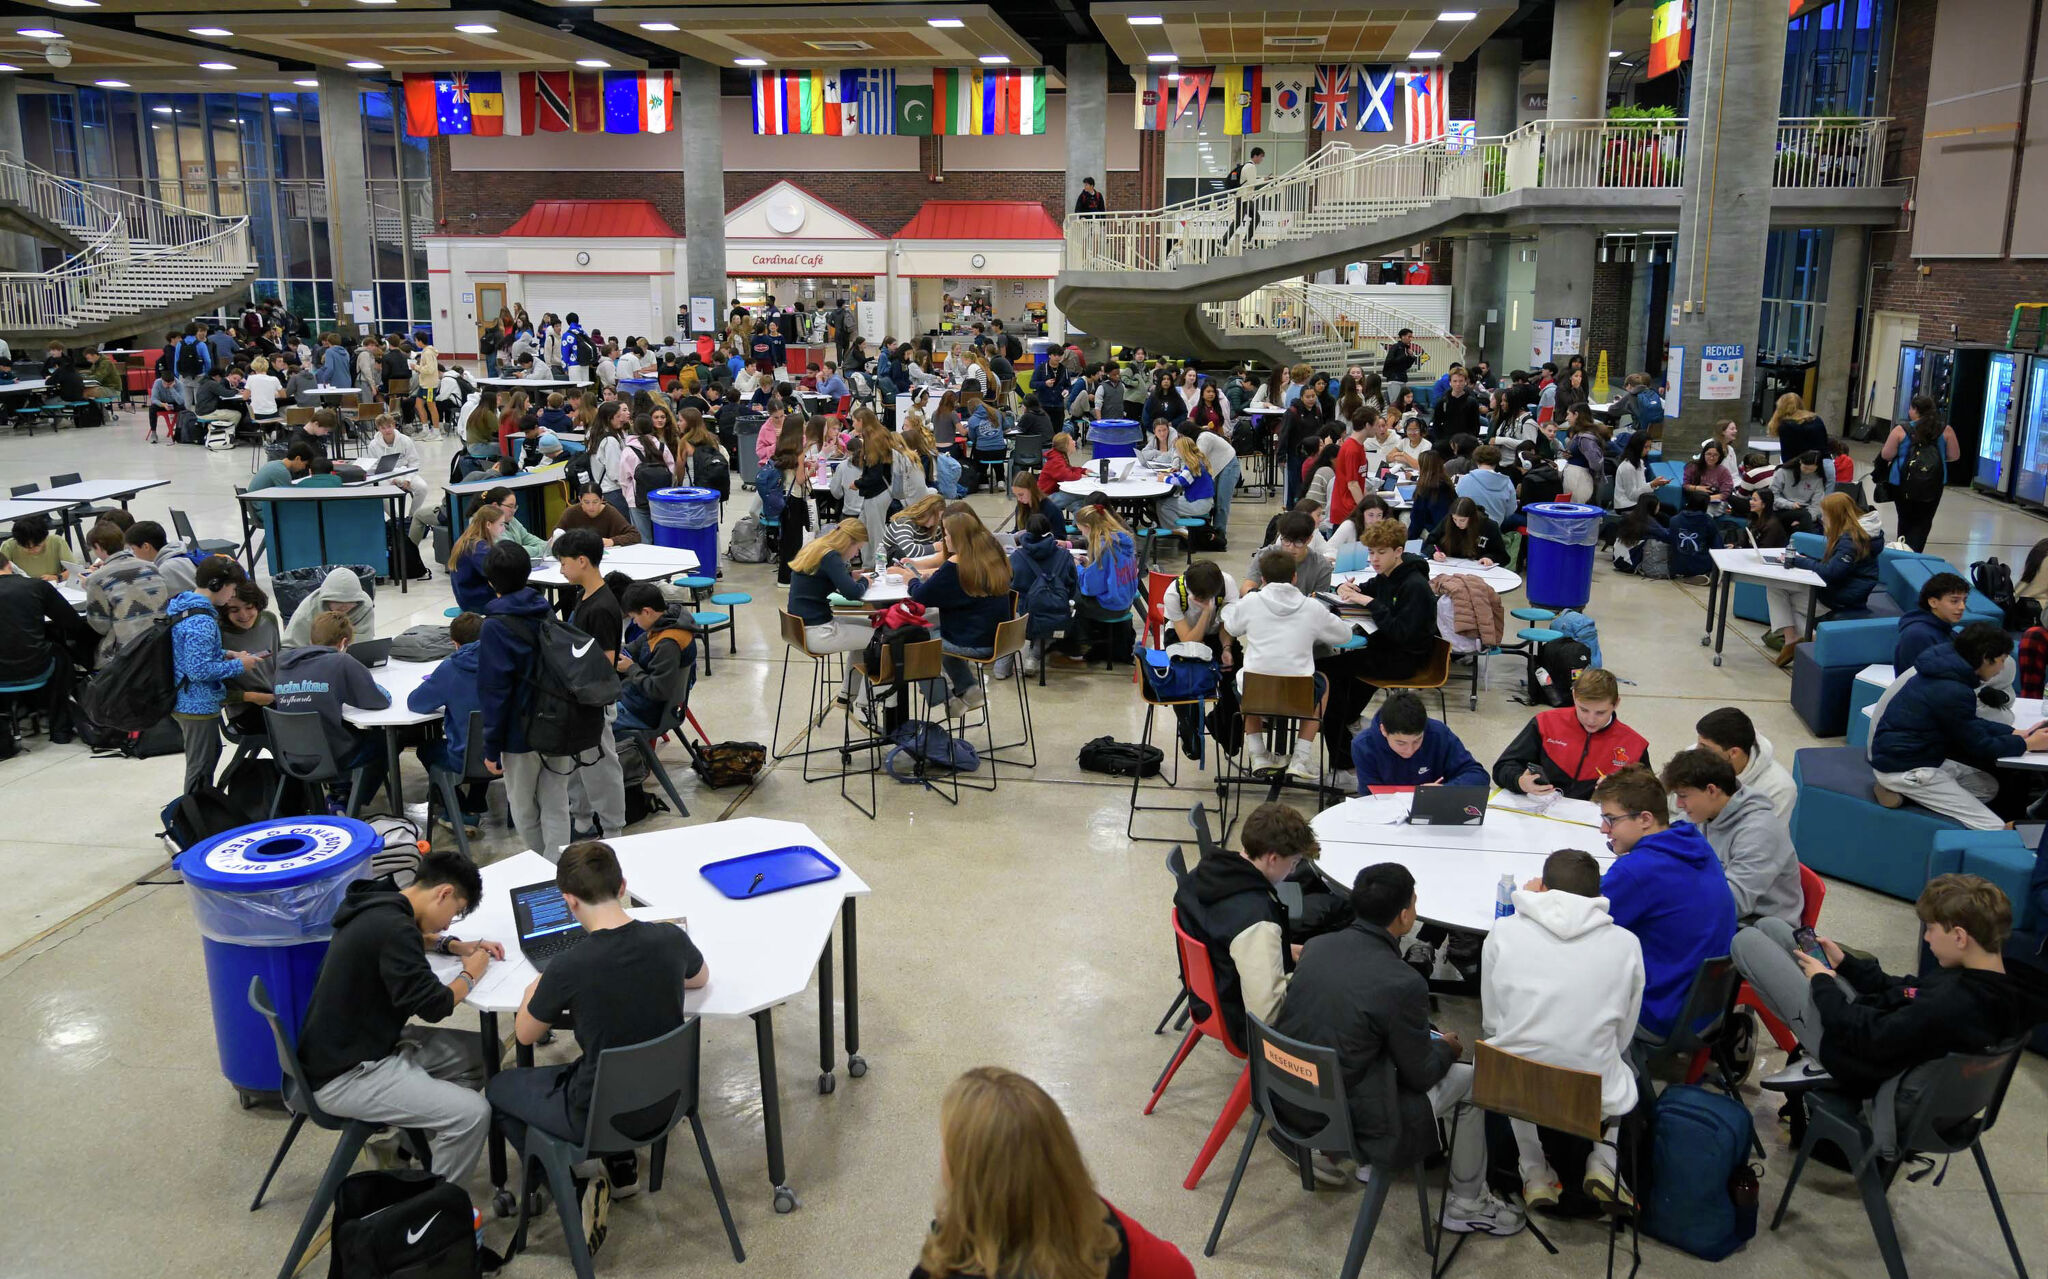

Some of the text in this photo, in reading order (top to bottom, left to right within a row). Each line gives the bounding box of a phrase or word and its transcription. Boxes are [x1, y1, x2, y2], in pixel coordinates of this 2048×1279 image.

[752, 254, 824, 268] Cardinal Café
[1705, 345, 1741, 357] RECYCLE
[1269, 1050, 1313, 1078] RESERVED
